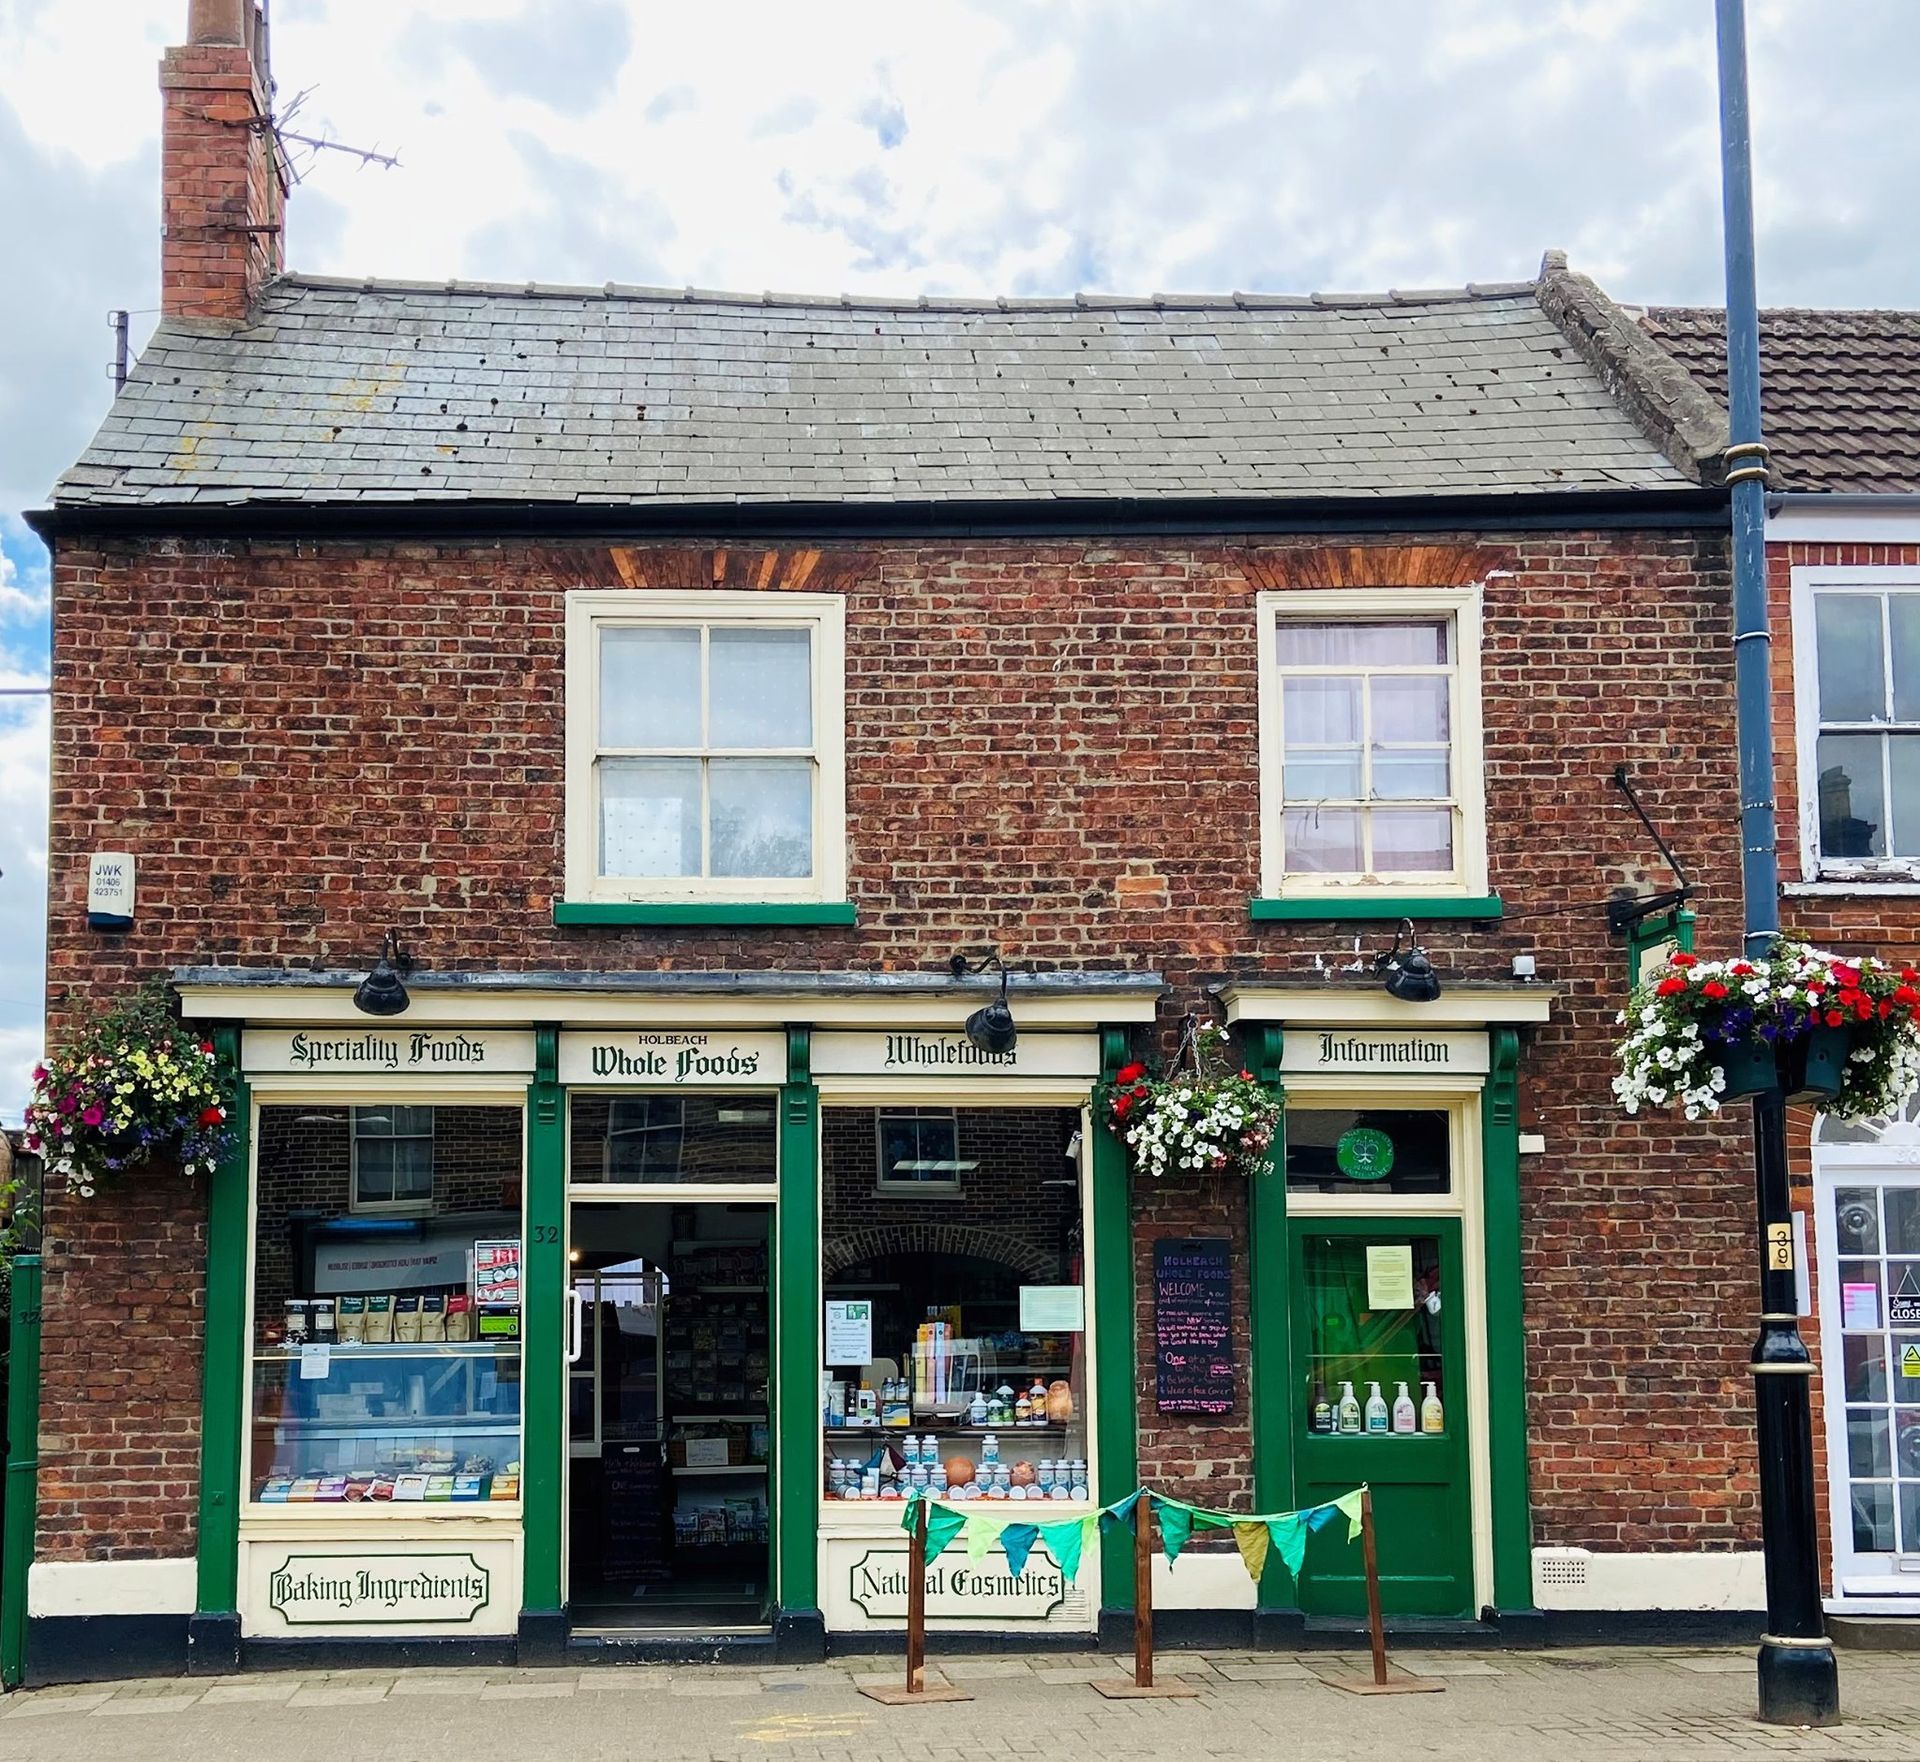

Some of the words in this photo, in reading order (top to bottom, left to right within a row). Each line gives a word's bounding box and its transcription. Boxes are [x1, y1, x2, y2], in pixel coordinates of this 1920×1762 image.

[95, 864, 122, 876] JWK
[289, 1032, 399, 1069] Speciality
[408, 1033, 487, 1066] Foods
[639, 1035, 708, 1045] HOLBEACH
[1318, 1033, 1449, 1065] Information
[592, 1046, 668, 1076] Whole
[674, 1047, 760, 1082] Foods
[534, 1225, 559, 1244] 32
[1159, 1282, 1206, 1297] WELCOME
[1165, 1351, 1185, 1365] One
[274, 1572, 352, 1608] Baking
[354, 1570, 484, 1607] Ingredients
[860, 1566, 945, 1602] Natual
[951, 1568, 1060, 1598] Cosmetics
